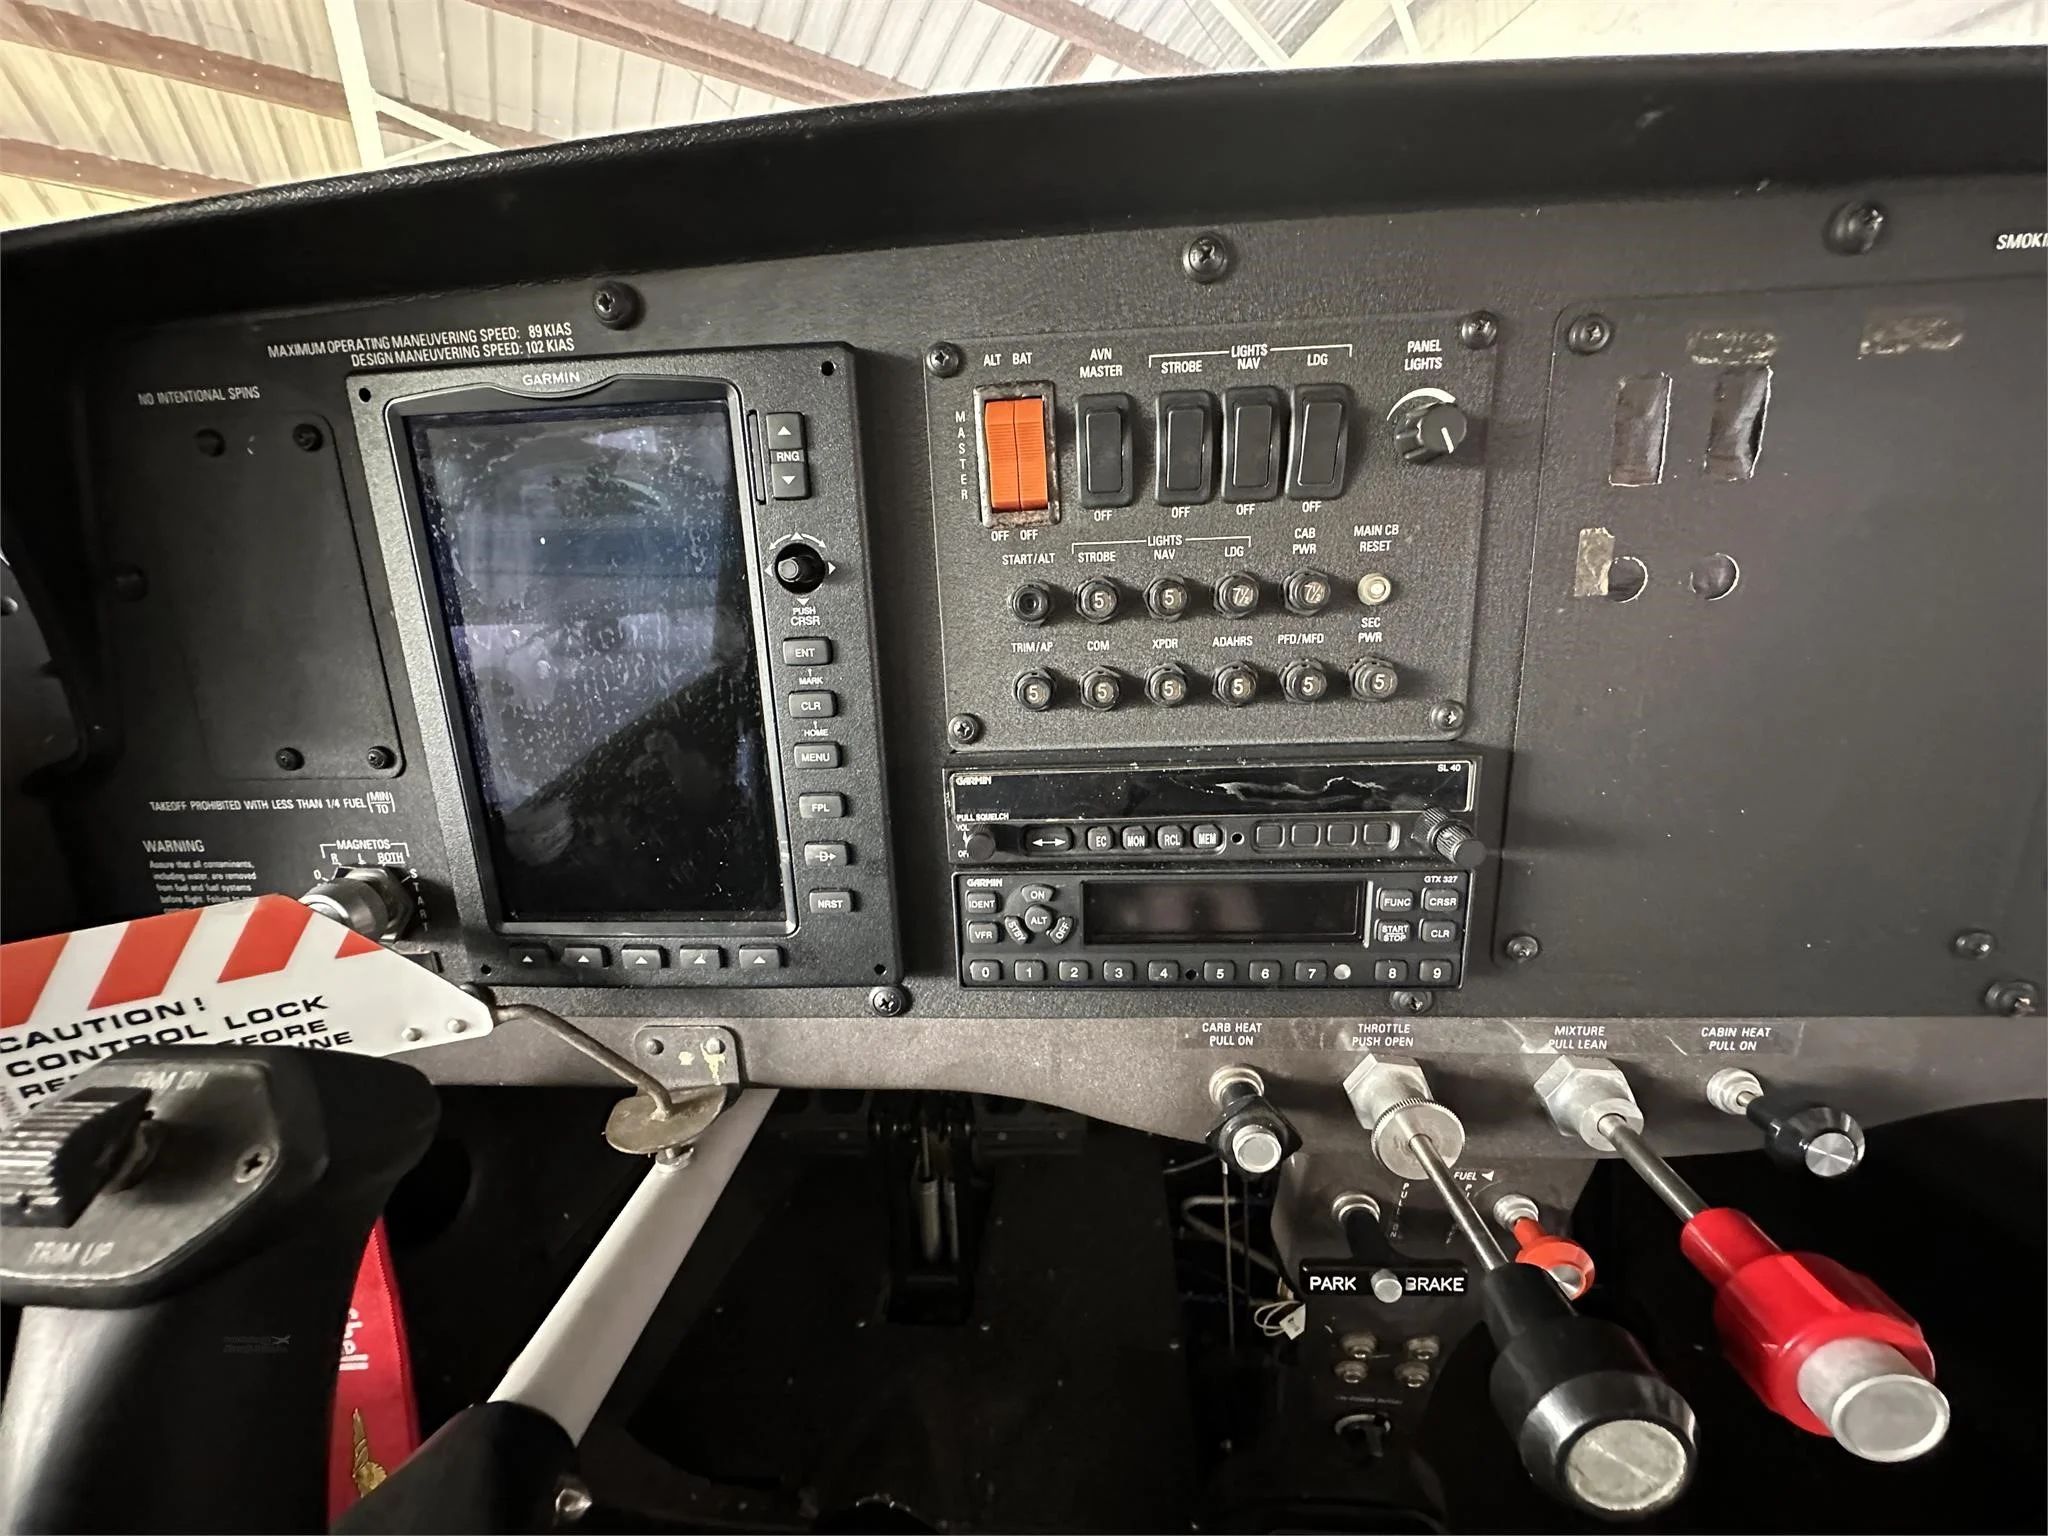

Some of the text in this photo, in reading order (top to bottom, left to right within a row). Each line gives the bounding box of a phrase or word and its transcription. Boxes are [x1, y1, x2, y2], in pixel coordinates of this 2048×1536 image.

[267, 322, 572, 359] MAXIMUM OPERATING MANEUVERING SPEED: 89 KIAS
[1231, 344, 1268, 358] LIGHTS
[1407, 340, 1441, 353] PANEL
[351, 338, 575, 367] DESIGN MANEUVERING SPEED: 102 KIAS
[1090, 348, 1112, 360] AVN
[984, 353, 1032, 366] ALT BAT
[1161, 355, 1328, 374] STROBE NAV LDG
[1404, 357, 1442, 371] LIGHTS
[1080, 365, 1123, 378] MASTER
[522, 371, 580, 386] GARMIN
[138, 386, 260, 405] NO INTENTIONAL SPINS
[777, 451, 800, 462] RNG
[955, 411, 968, 500] MASTER
[1236, 504, 1255, 516] OFF
[1302, 501, 1321, 513] OFF
[1094, 510, 1112, 521] OFF
[1171, 507, 1191, 519] OFF
[991, 529, 1038, 541] OFF OFF
[1295, 527, 1315, 539] CAB
[1354, 524, 1399, 536] MAIN CB
[1148, 535, 1182, 546] LIGHTS
[1360, 540, 1391, 552] RESET
[1154, 550, 1175, 560] NAV
[1225, 546, 1244, 558] LDG
[1293, 544, 1316, 555] PWR
[1002, 552, 1055, 565] START/ALT
[1078, 551, 1116, 563] STROBE
[1095, 593, 1104, 608] 5
[1164, 590, 1174, 605] 5
[792, 607, 816, 615] PUSH
[790, 616, 820, 626] CRSR
[1361, 617, 1380, 628] SEC
[1212, 636, 1253, 647] ADAHRS
[1278, 634, 1324, 645] PFD/MFD
[1358, 632, 1382, 643] PWR
[1011, 641, 1053, 652] TRIM/AP
[1087, 641, 1109, 651] COM
[1152, 639, 1179, 649] XPDR
[795, 648, 815, 657] ENT
[799, 677, 823, 685] MARK
[1234, 678, 1244, 694] 5
[1303, 676, 1314, 692] 5
[1375, 674, 1385, 689] 5
[1029, 687, 1038, 700] 5
[1098, 684, 1107, 698] 5
[1164, 681, 1174, 695] 5
[801, 702, 821, 711] CLR
[802, 753, 830, 761] MENU
[1437, 764, 1448, 772] SL
[956, 776, 992, 785] GARMIN
[149, 798, 367, 811] TAKEOFF PROHIBITED WITH LESS THAN 1/4 FUEL
[812, 804, 830, 812] FPL
[957, 813, 1009, 822] PULL SQUELCH
[1096, 836, 1106, 848] EC
[1128, 835, 1145, 847] MON
[1164, 834, 1180, 846] RCL
[1199, 832, 1216, 844] MEM
[142, 840, 205, 852] WARNING
[336, 839, 391, 849] MAGNETOS
[377, 852, 404, 863] BOTH
[967, 878, 1002, 888] GARMIN
[1030, 891, 1044, 899] ON
[818, 900, 843, 908] NRST
[969, 900, 995, 908] IDENT
[1384, 898, 1411, 906] FUNC
[1031, 916, 1047, 924] ALT
[975, 931, 992, 939] VFR
[1008, 921, 1026, 941] STBY
[1056, 922, 1069, 940] OFF
[1430, 930, 1450, 938] CLR
[982, 968, 989, 977] 0
[1027, 968, 1032, 978] 1
[1070, 967, 1078, 977] 2
[1115, 968, 1123, 978] 3
[1160, 968, 1168, 978] 4
[1216, 968, 1224, 979] 5
[1261, 968, 1269, 979] 6
[1308, 969, 1316, 979] 7
[1389, 968, 1396, 978] 8
[1433, 968, 1441, 979] 9
[224, 995, 328, 1030] LOCK
[1202, 1023, 1262, 1032] CARB HEAT
[1358, 1024, 1410, 1034] THROTTLE
[1554, 1026, 1605, 1036] MIXTURE
[1701, 1027, 1771, 1037] CABIN HEAT
[1209, 1036, 1253, 1047] PULL ON
[1352, 1037, 1414, 1047] PUSH OPEN
[1548, 1039, 1607, 1049] PULL LEAN
[1709, 1041, 1757, 1051] PULL ON
[1454, 1171, 1477, 1181] FUEL
[1310, 1277, 1464, 1292] PARK BRAKE
